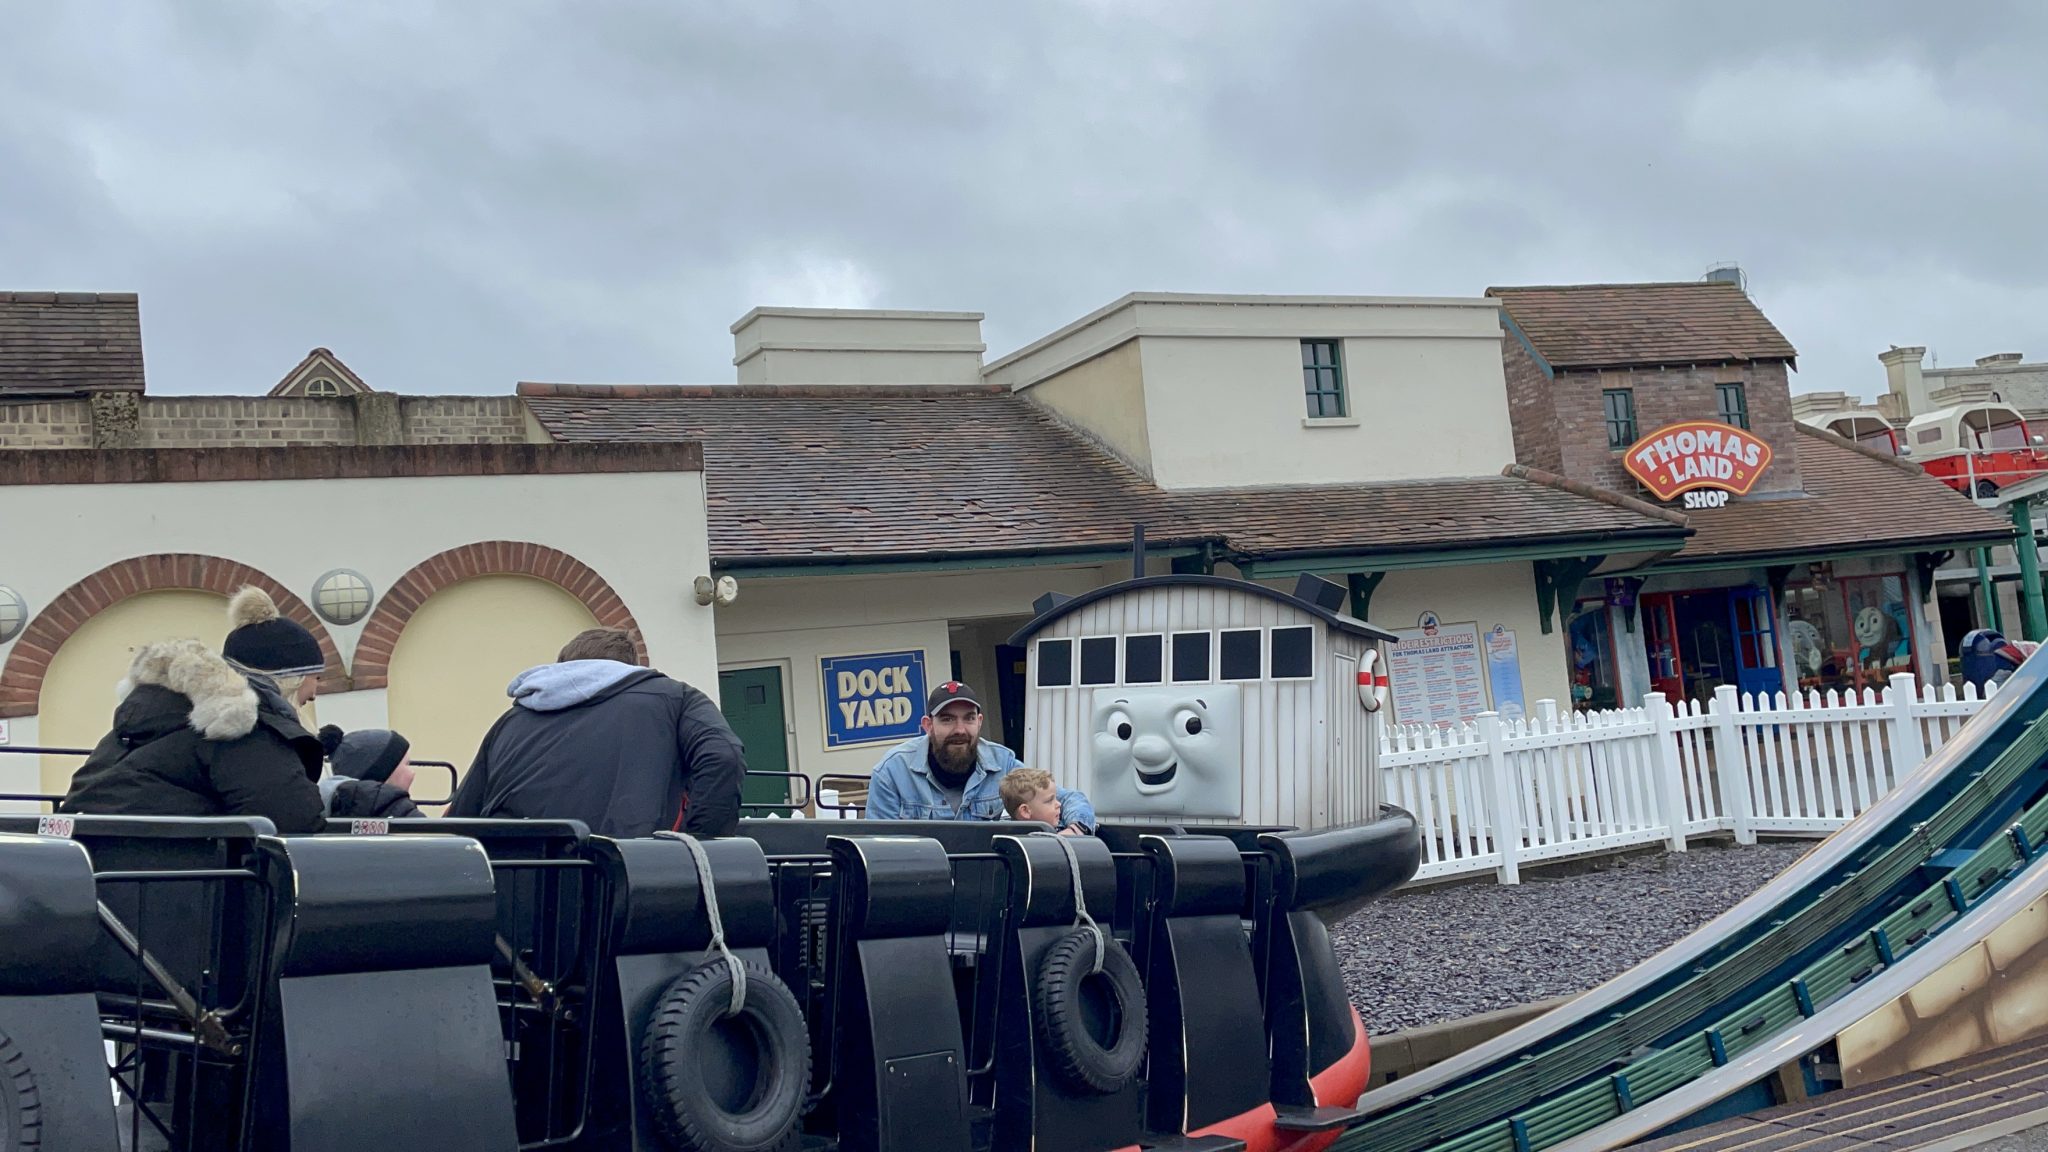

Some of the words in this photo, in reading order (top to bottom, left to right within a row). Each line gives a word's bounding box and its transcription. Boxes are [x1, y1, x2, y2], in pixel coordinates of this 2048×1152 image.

[1636, 430, 1761, 472] THOMAS
[1668, 456, 1733, 484] LAND
[1684, 491, 1729, 509] SHOP
[1403, 648, 1425, 657] THOMAS
[1440, 643, 1474, 652] ATTRACTIONS
[1413, 634, 1473, 649] RESTRICTIONS
[837, 666, 912, 699] DOCK
[838, 697, 912, 730] YARD
